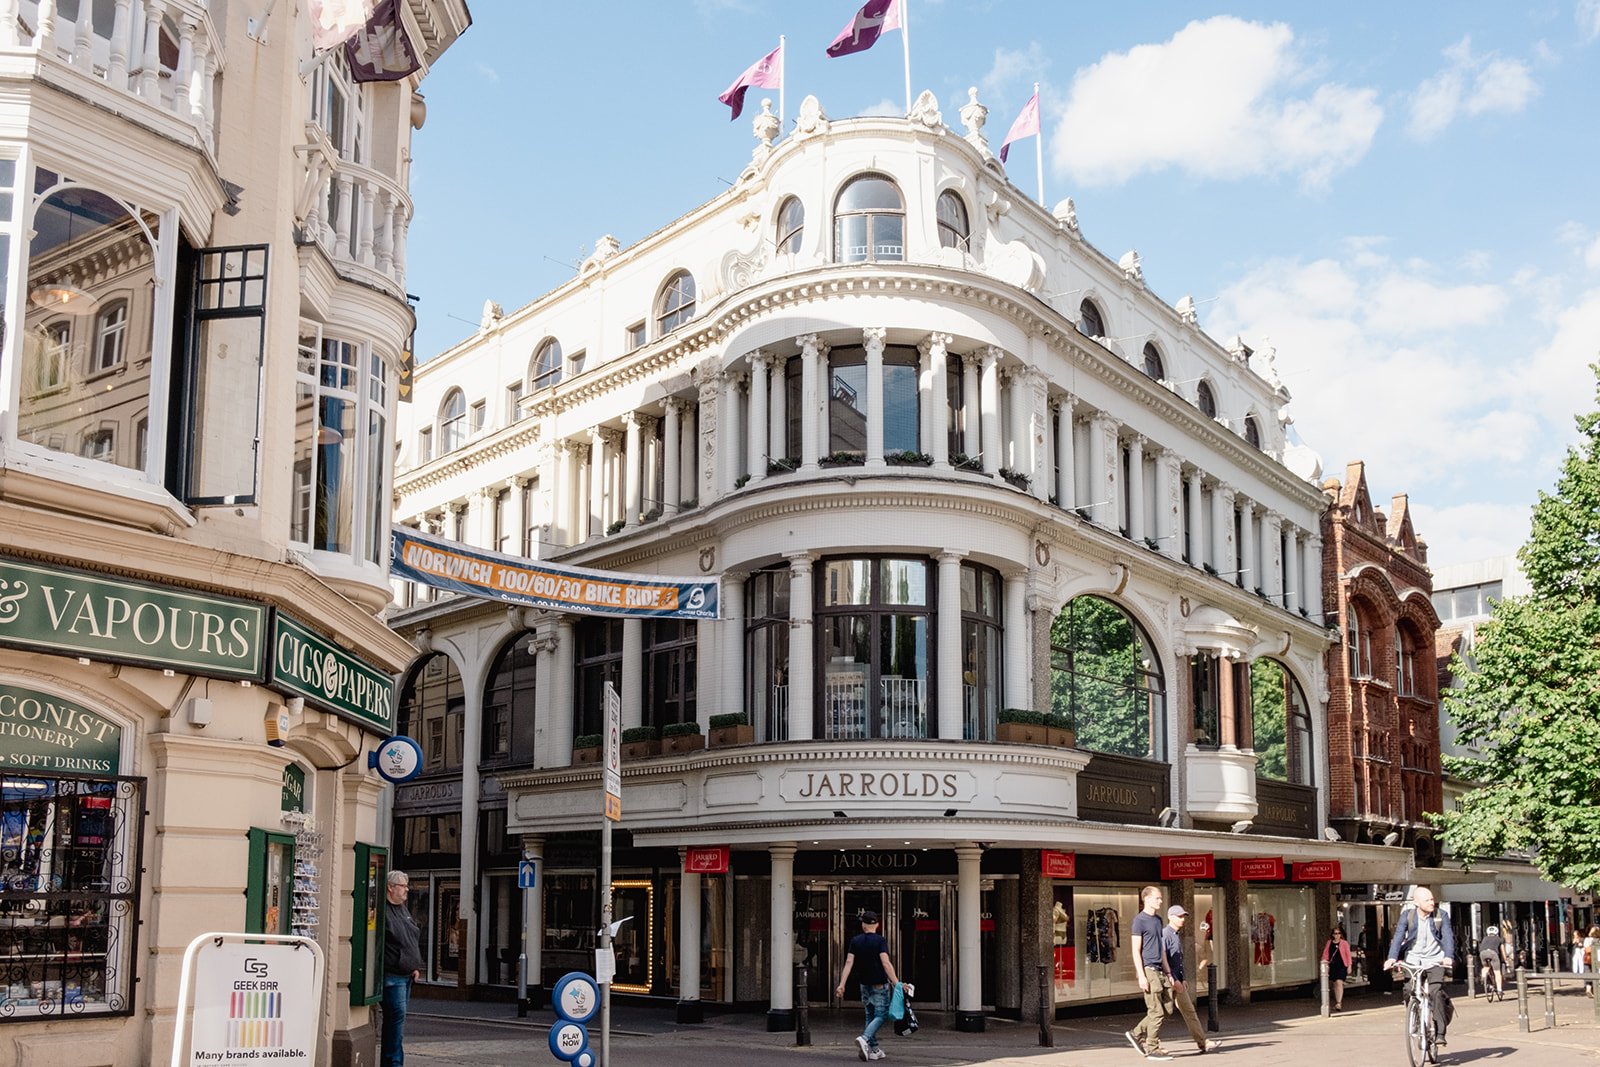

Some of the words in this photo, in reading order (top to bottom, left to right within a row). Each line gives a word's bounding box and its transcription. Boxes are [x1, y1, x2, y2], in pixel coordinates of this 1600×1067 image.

[407, 545, 493, 585] NORWICH
[498, 569, 581, 600] 100/60/30
[585, 583, 621, 604] BIKE
[625, 587, 660, 607] RIDE
[40, 585, 249, 658] VAPOURS
[10, 753, 51, 767] SOFT
[55, 756, 111, 771] DRINKS
[409, 783, 453, 801] JARROLDS
[799, 773, 958, 798] JARROLDS
[1086, 784, 1138, 806] JARROLDS
[831, 853, 918, 872] JARROLD
[233, 981, 258, 990] GEEK
[260, 981, 278, 990] BAR
[195, 1051, 223, 1061] Many
[226, 1050, 260, 1060] brands
[262, 1049, 307, 1059] available.
